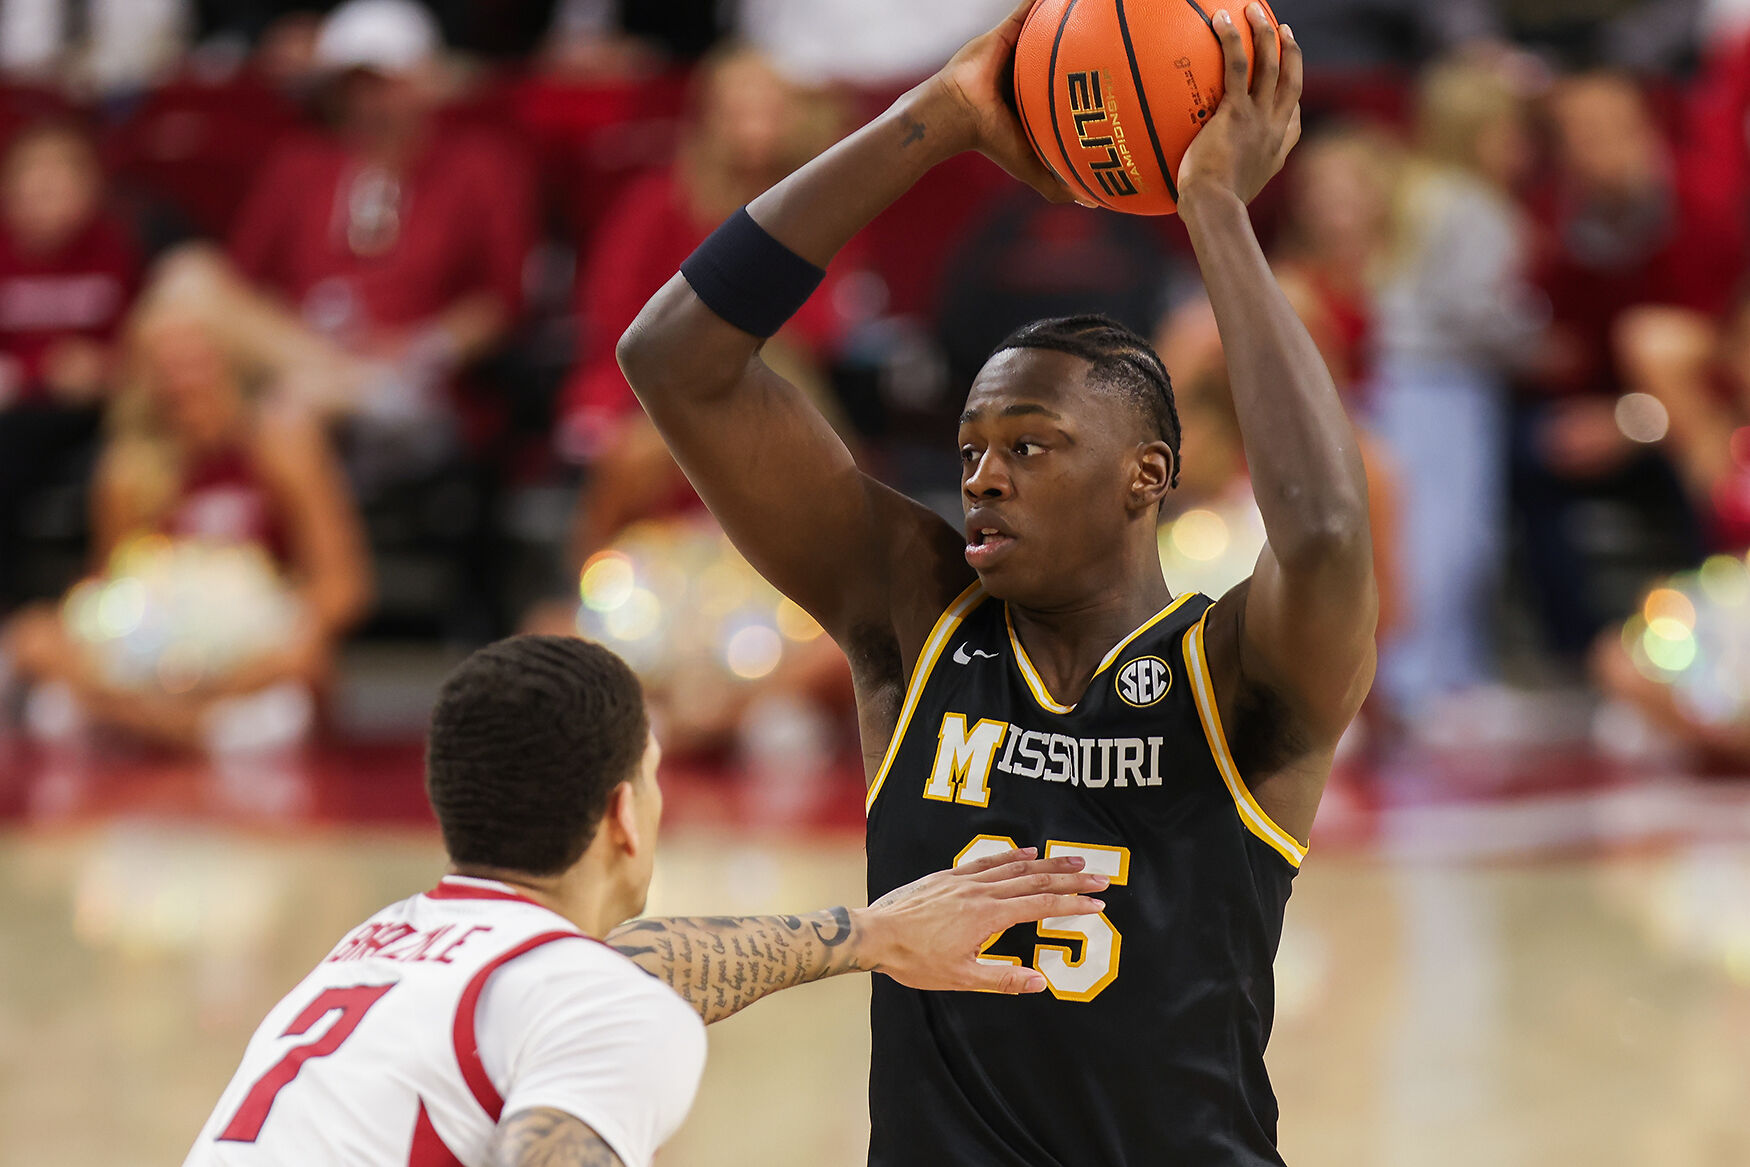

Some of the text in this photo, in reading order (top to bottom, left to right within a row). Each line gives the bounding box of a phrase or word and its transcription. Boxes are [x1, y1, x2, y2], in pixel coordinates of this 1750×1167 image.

[1066, 70, 1139, 197] ELITE
[1103, 68, 1149, 194] HAMPIONSHIP
[1119, 655, 1168, 704] SEC
[922, 711, 1164, 808] MISSOURI
[213, 979, 401, 1144] 7
